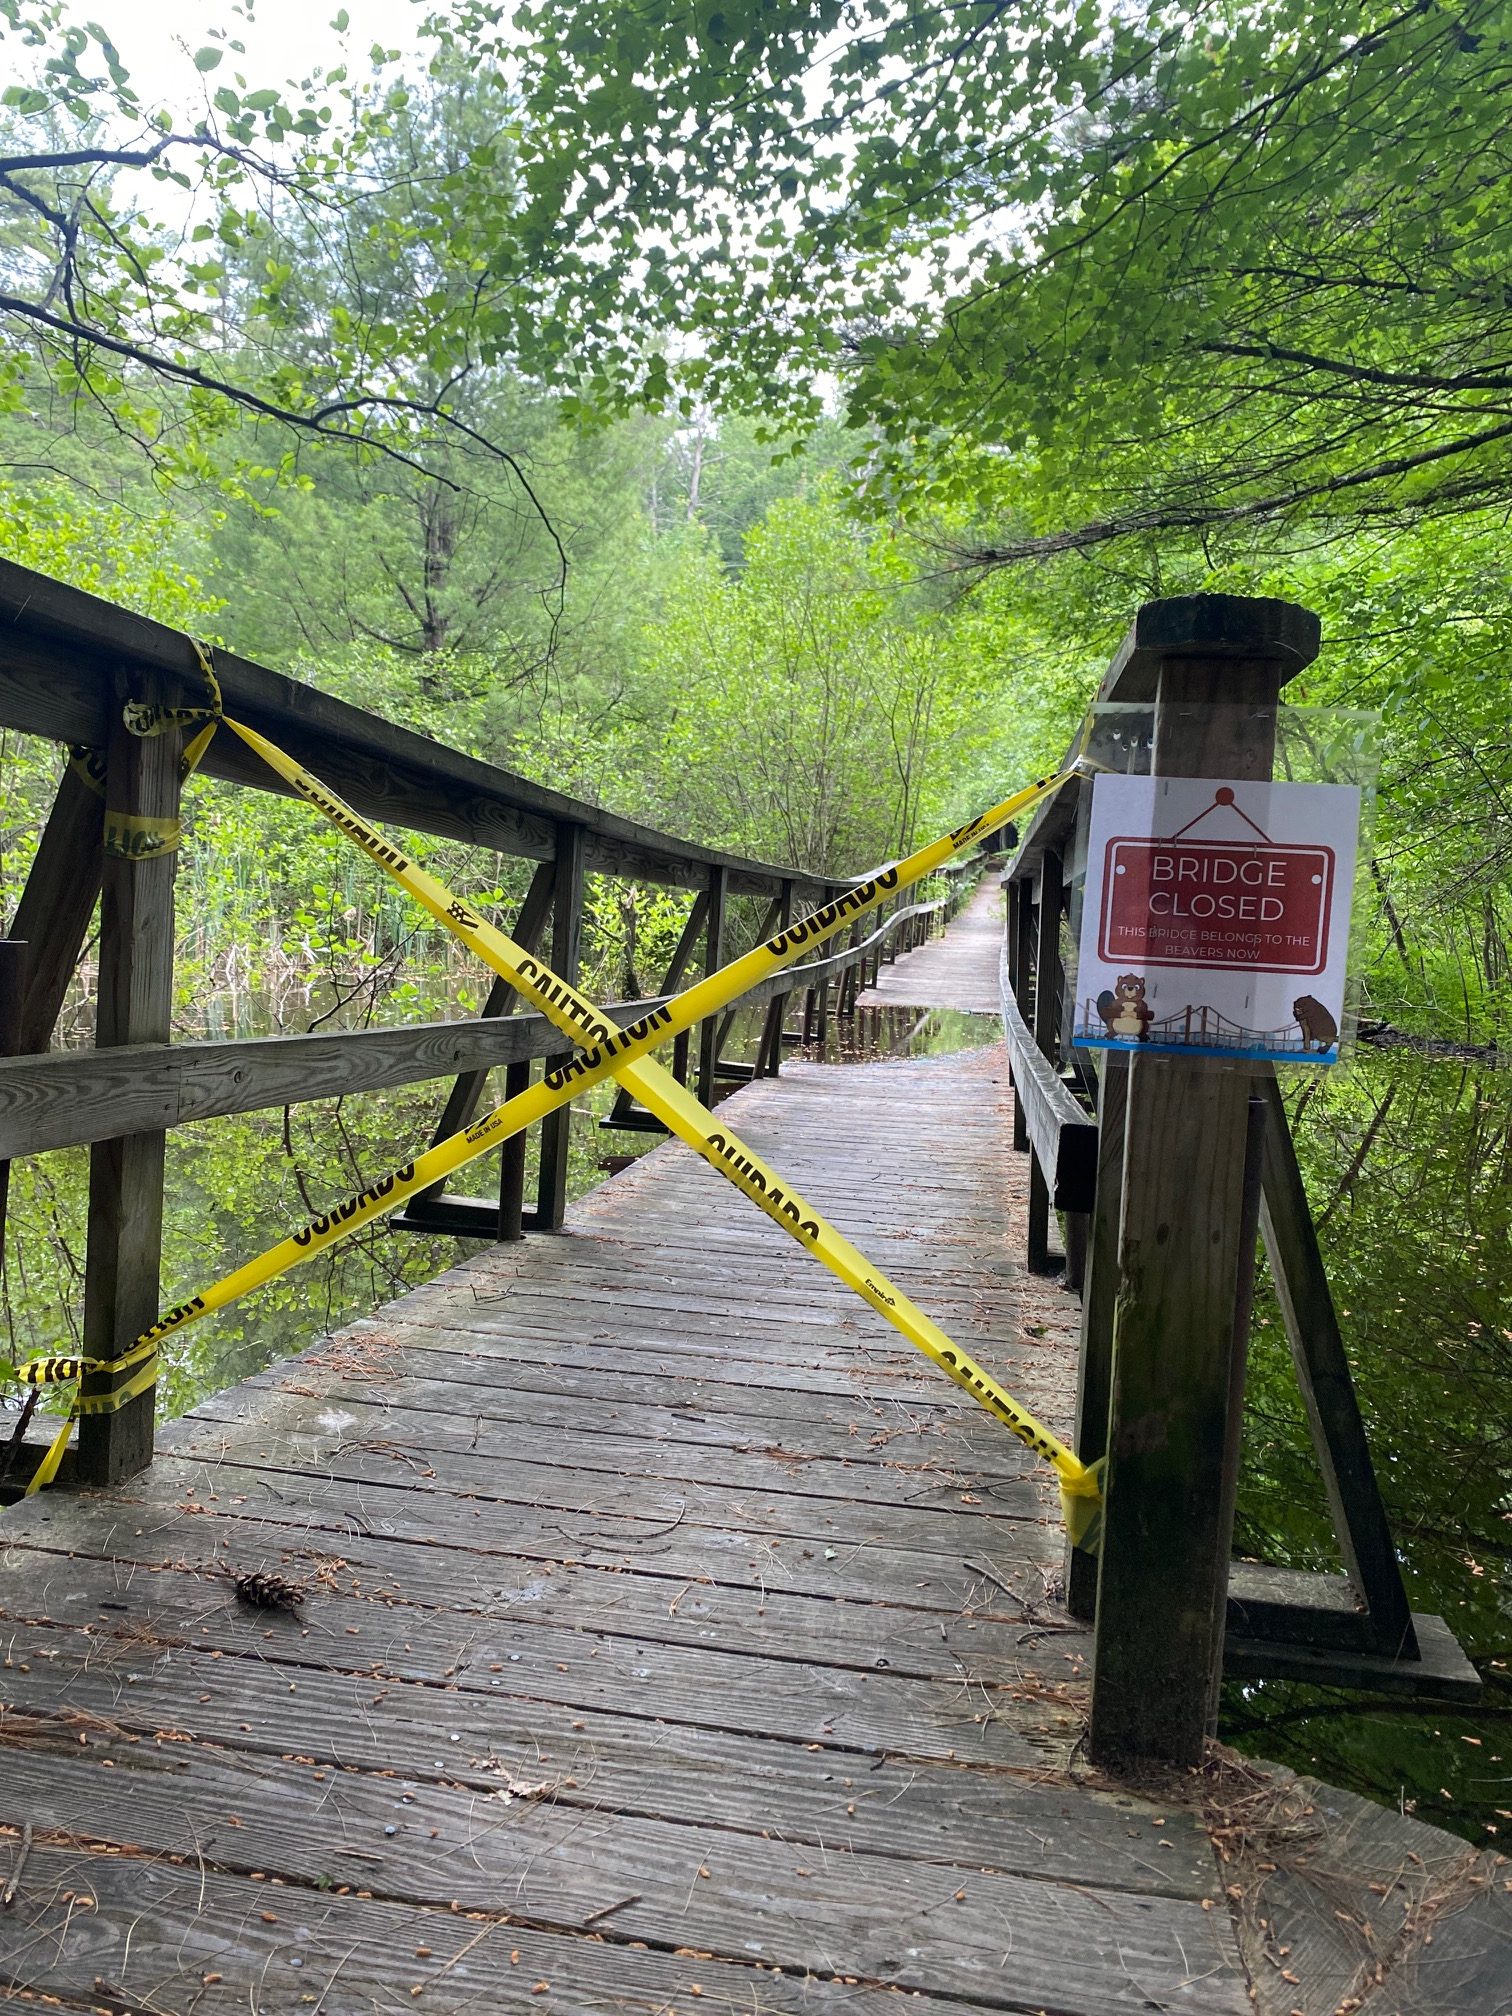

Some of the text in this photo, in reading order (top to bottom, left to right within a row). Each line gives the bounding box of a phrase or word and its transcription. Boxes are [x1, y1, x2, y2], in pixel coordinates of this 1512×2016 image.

[1153, 856, 1287, 887] BRIDGE
[1149, 892, 1284, 921] CLOSED
[1118, 926, 1310, 946] THIS BRIDGE BELONGS TO THE
[1165, 945, 1261, 960] BEAVERS NOW
[466, 1118, 504, 1144] MADE IN USA
